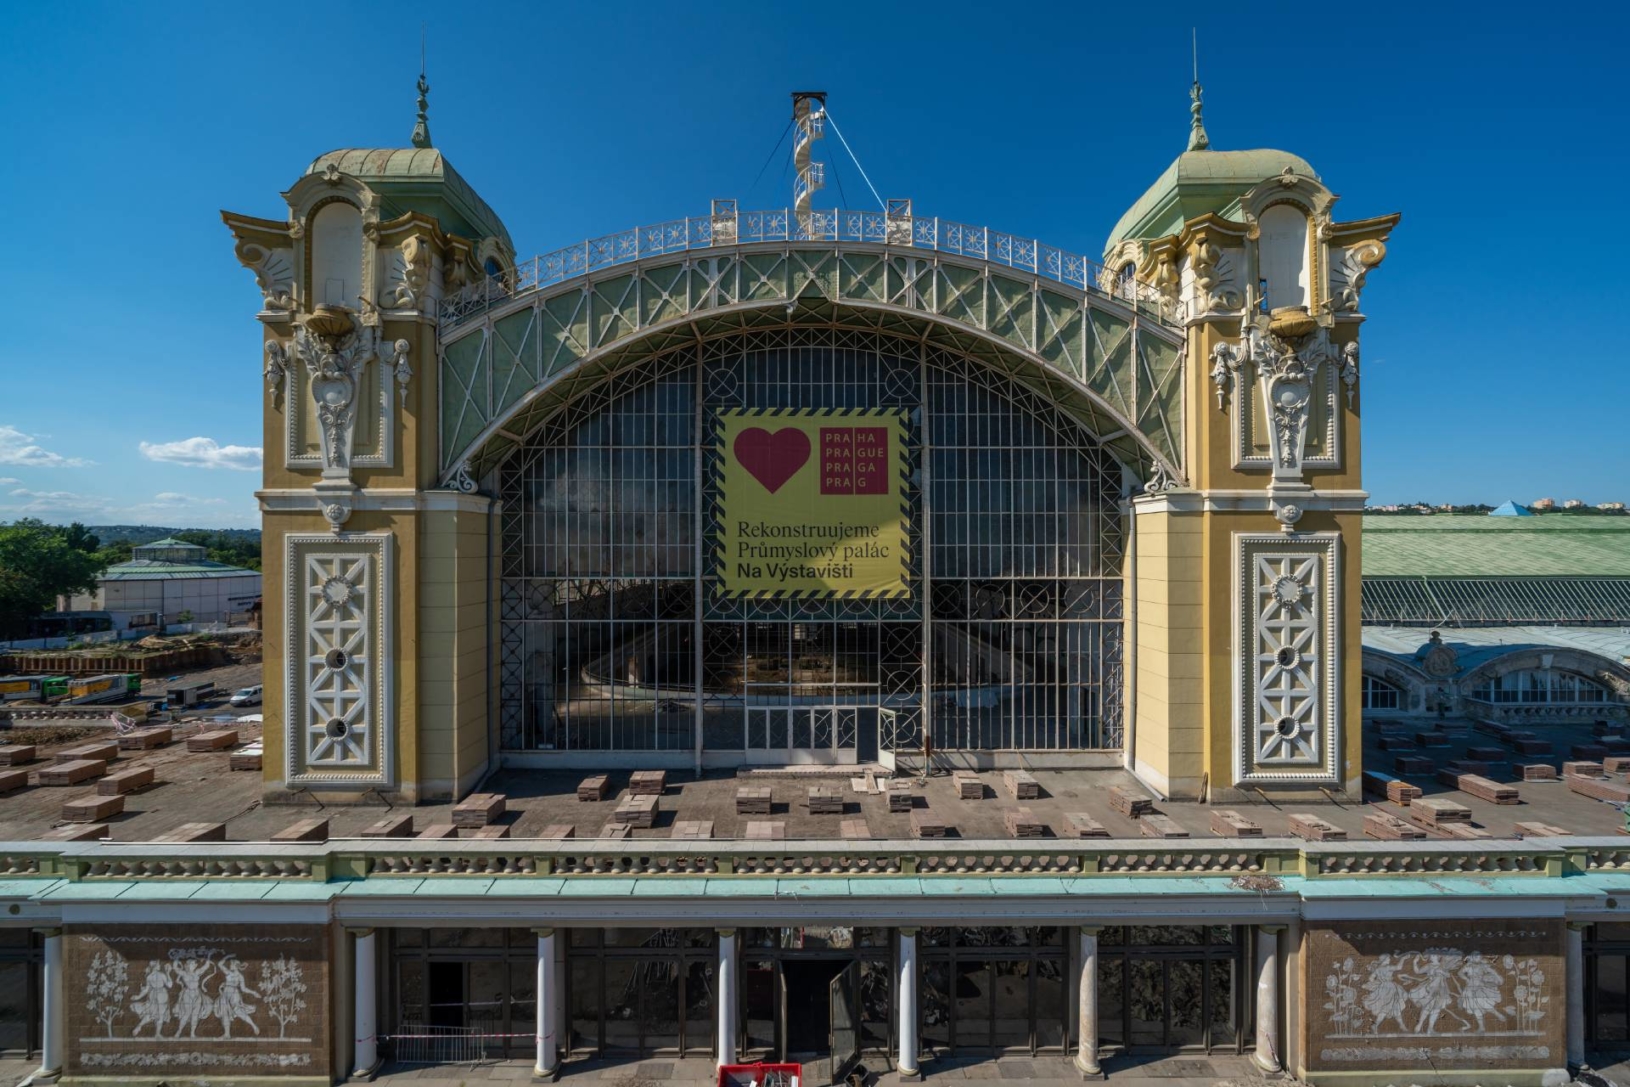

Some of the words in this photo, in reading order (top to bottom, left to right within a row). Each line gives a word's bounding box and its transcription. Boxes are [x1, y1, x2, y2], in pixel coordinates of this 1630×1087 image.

[737, 521, 880, 541] Rekonstruujeme
[737, 541, 838, 562] Průmyslový
[843, 541, 890, 562] palác
[737, 563, 762, 578] Na
[766, 562, 853, 582] Výstavišti
